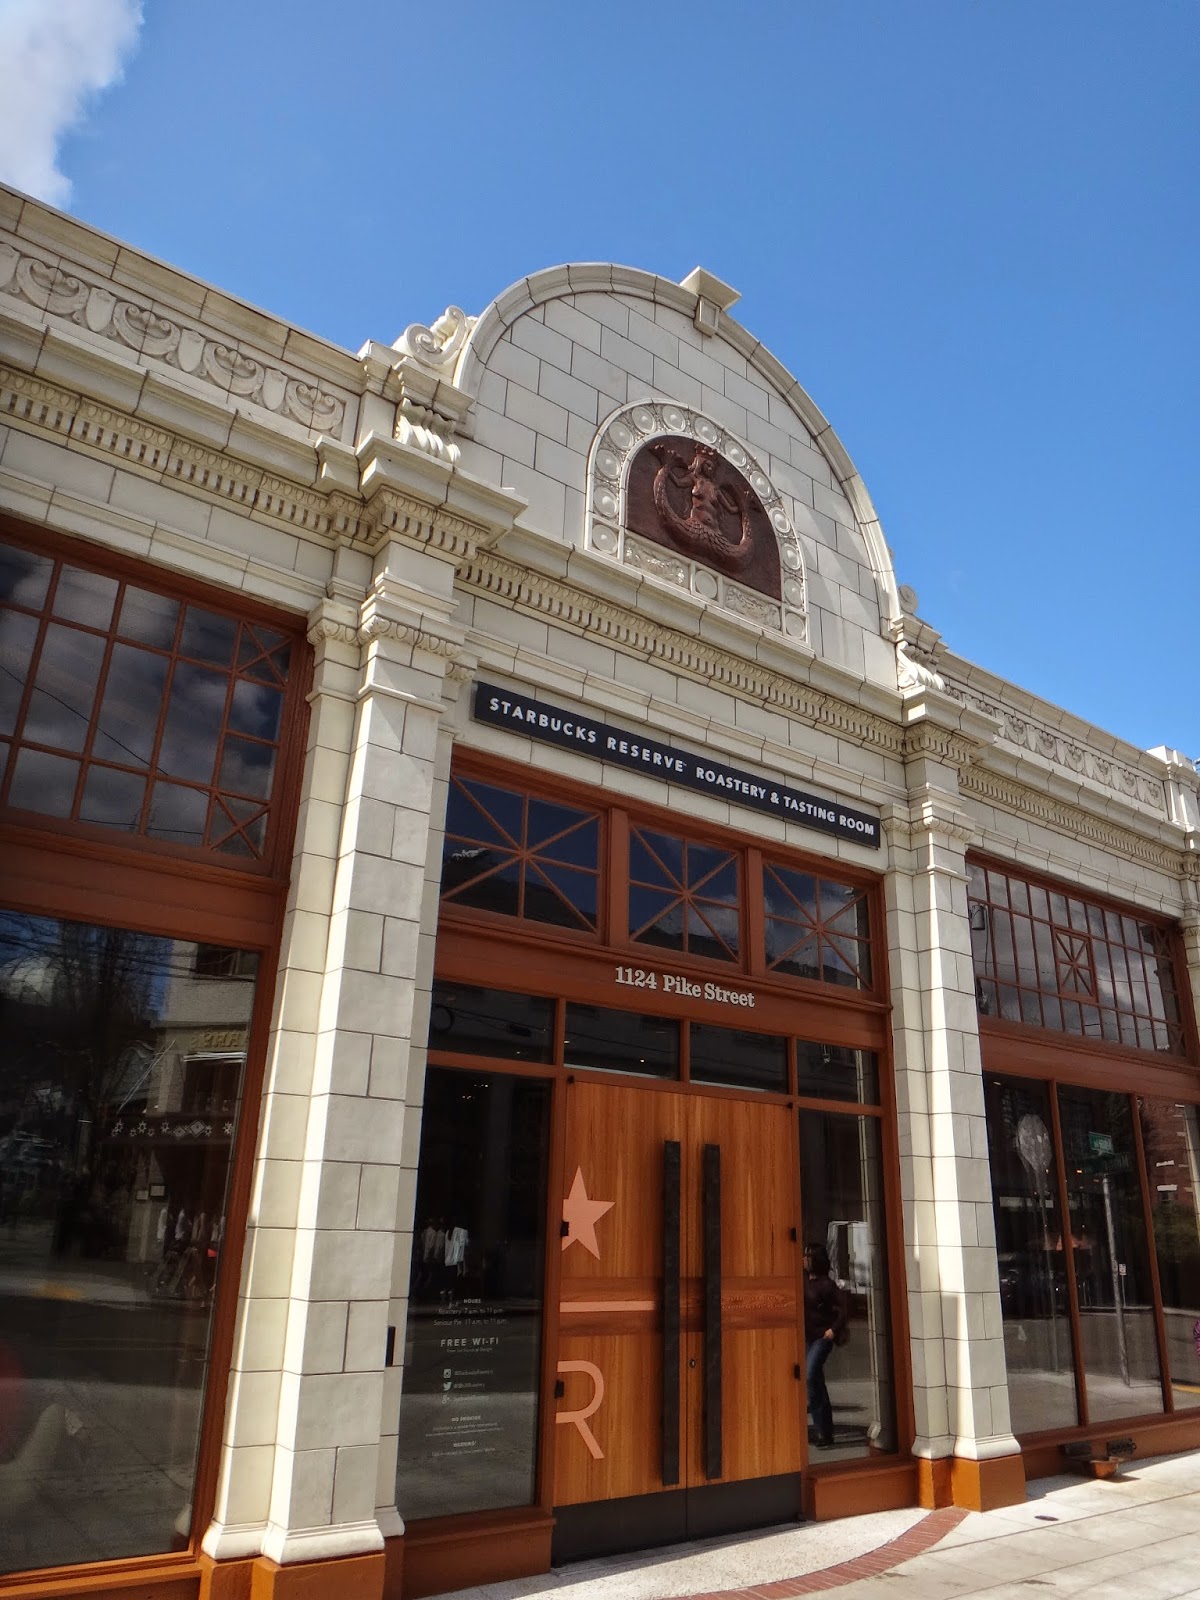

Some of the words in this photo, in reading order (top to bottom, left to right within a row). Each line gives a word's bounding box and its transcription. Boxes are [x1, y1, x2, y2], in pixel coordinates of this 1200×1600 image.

[489, 698, 597, 743] STARBUCKS
[606, 736, 684, 773] RESERVE
[695, 766, 766, 800] ROASTERY
[770, 792, 780, 804] &
[783, 795, 836, 824] TASTING
[839, 814, 875, 836] ROOM
[615, 966, 657, 989] 1124
[662, 974, 701, 998] Pike
[704, 983, 755, 1007] Street
[440, 1338, 467, 1347] FREE
[472, 1336, 499, 1346] WI-FI
[556, 1360, 605, 1459] R
